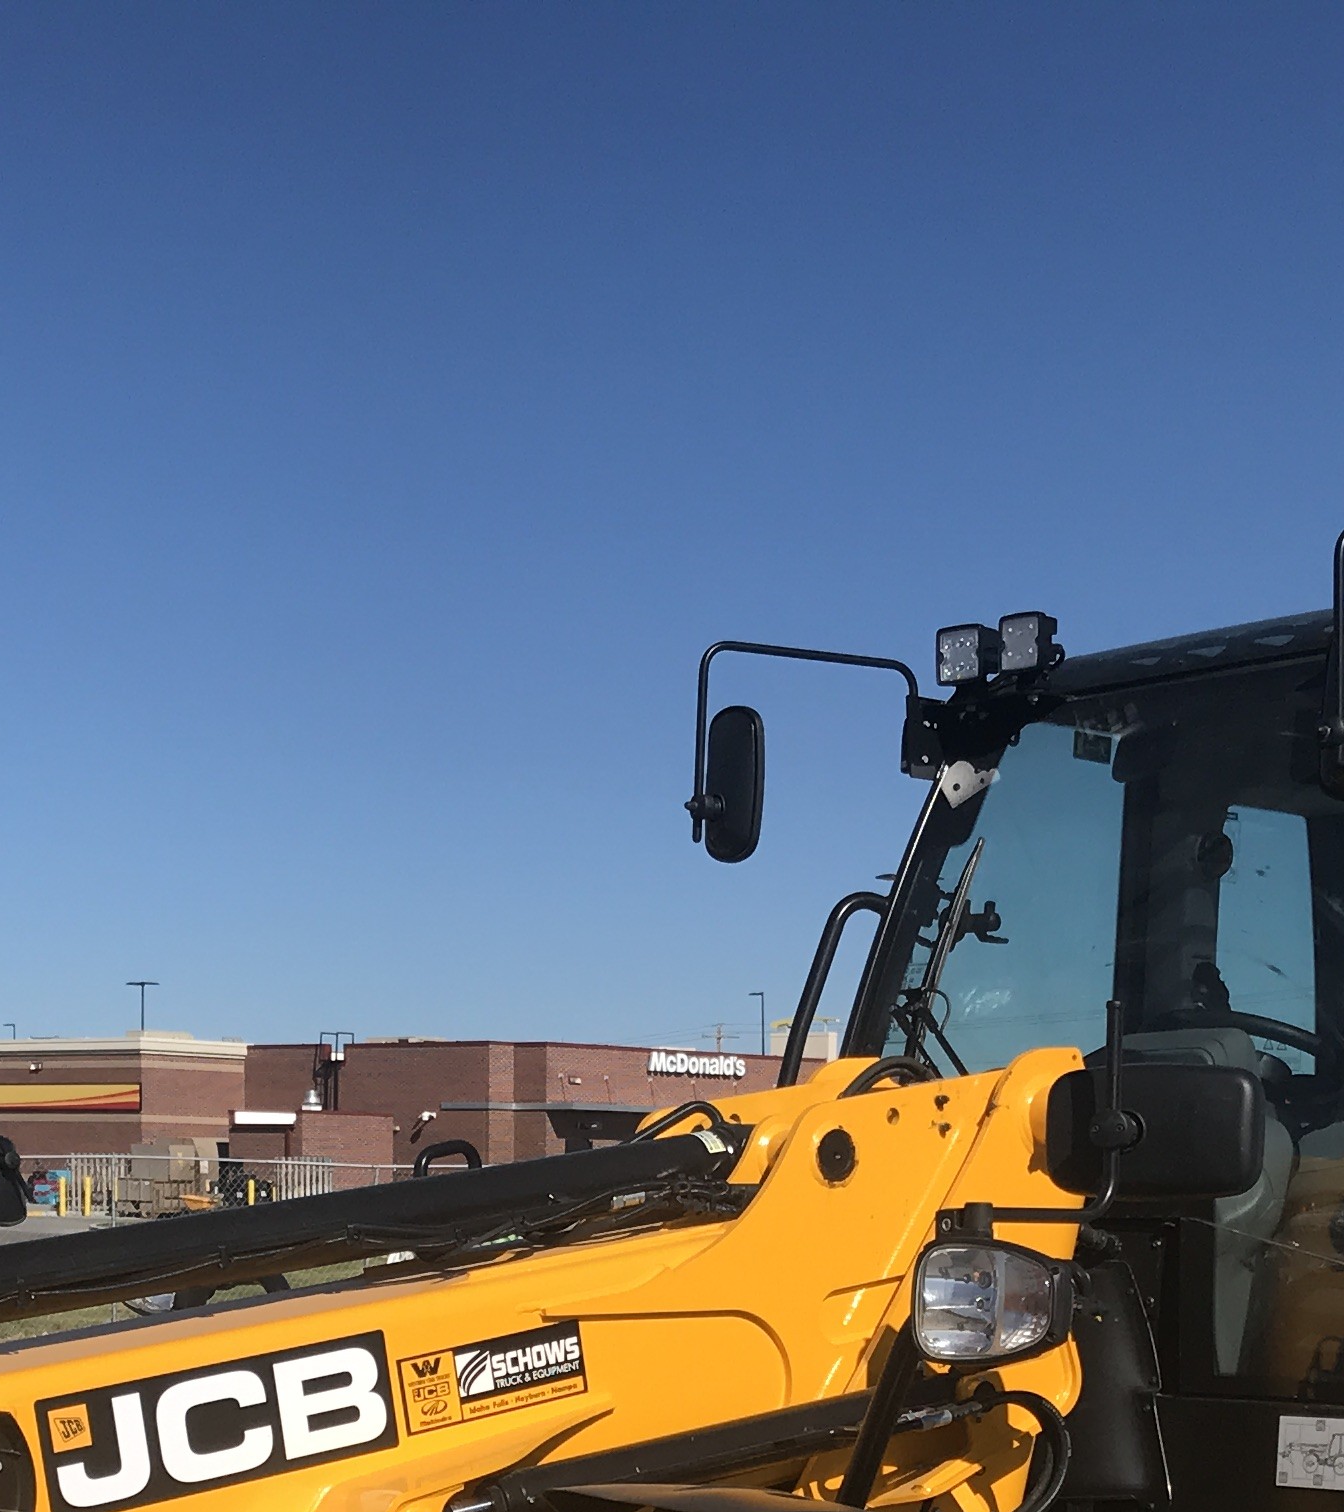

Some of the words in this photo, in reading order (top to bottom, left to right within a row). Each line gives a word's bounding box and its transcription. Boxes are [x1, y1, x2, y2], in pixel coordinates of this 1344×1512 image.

[648, 1051, 746, 1076] McDonald's
[490, 1336, 580, 1378] SCHOWS
[495, 1374, 523, 1389] TRUCK
[524, 1373, 531, 1383] &
[532, 1360, 580, 1380] EQUIPMENT
[413, 1383, 450, 1402] JCB
[56, 1347, 387, 1508] JCB
[59, 1419, 84, 1439] JCB
